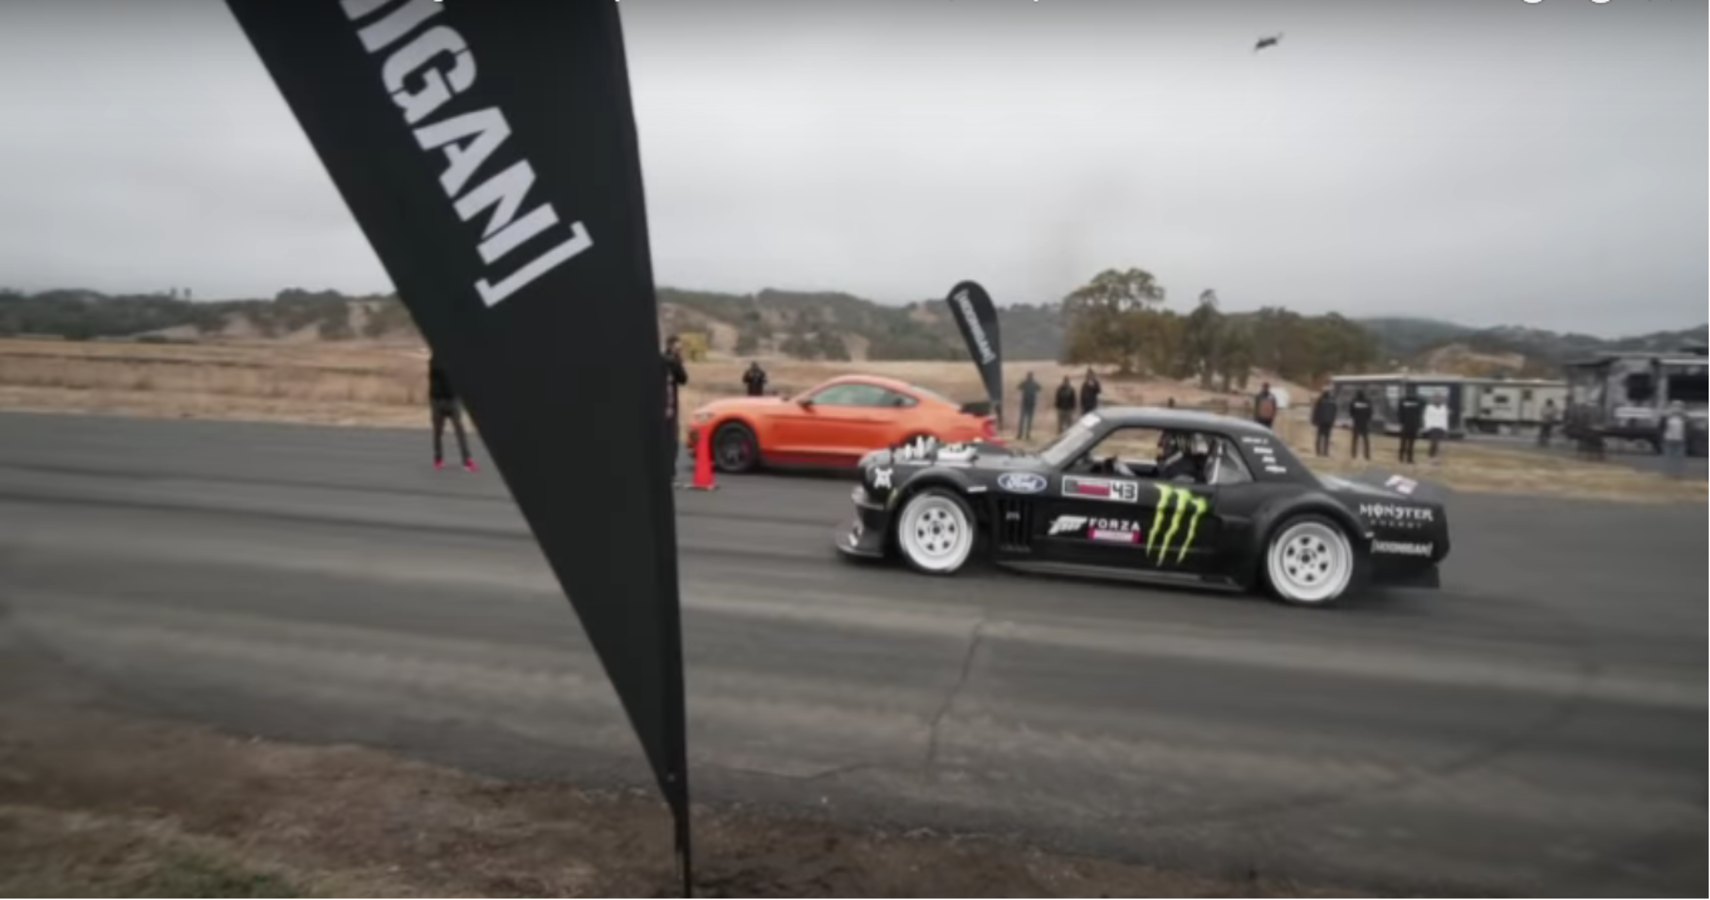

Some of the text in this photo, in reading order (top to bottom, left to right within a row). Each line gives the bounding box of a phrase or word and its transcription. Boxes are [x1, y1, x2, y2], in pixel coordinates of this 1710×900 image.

[1113, 481, 1137, 499] 43
[1359, 503, 1433, 521] MONSTER
[1089, 518, 1140, 531] FORZA
